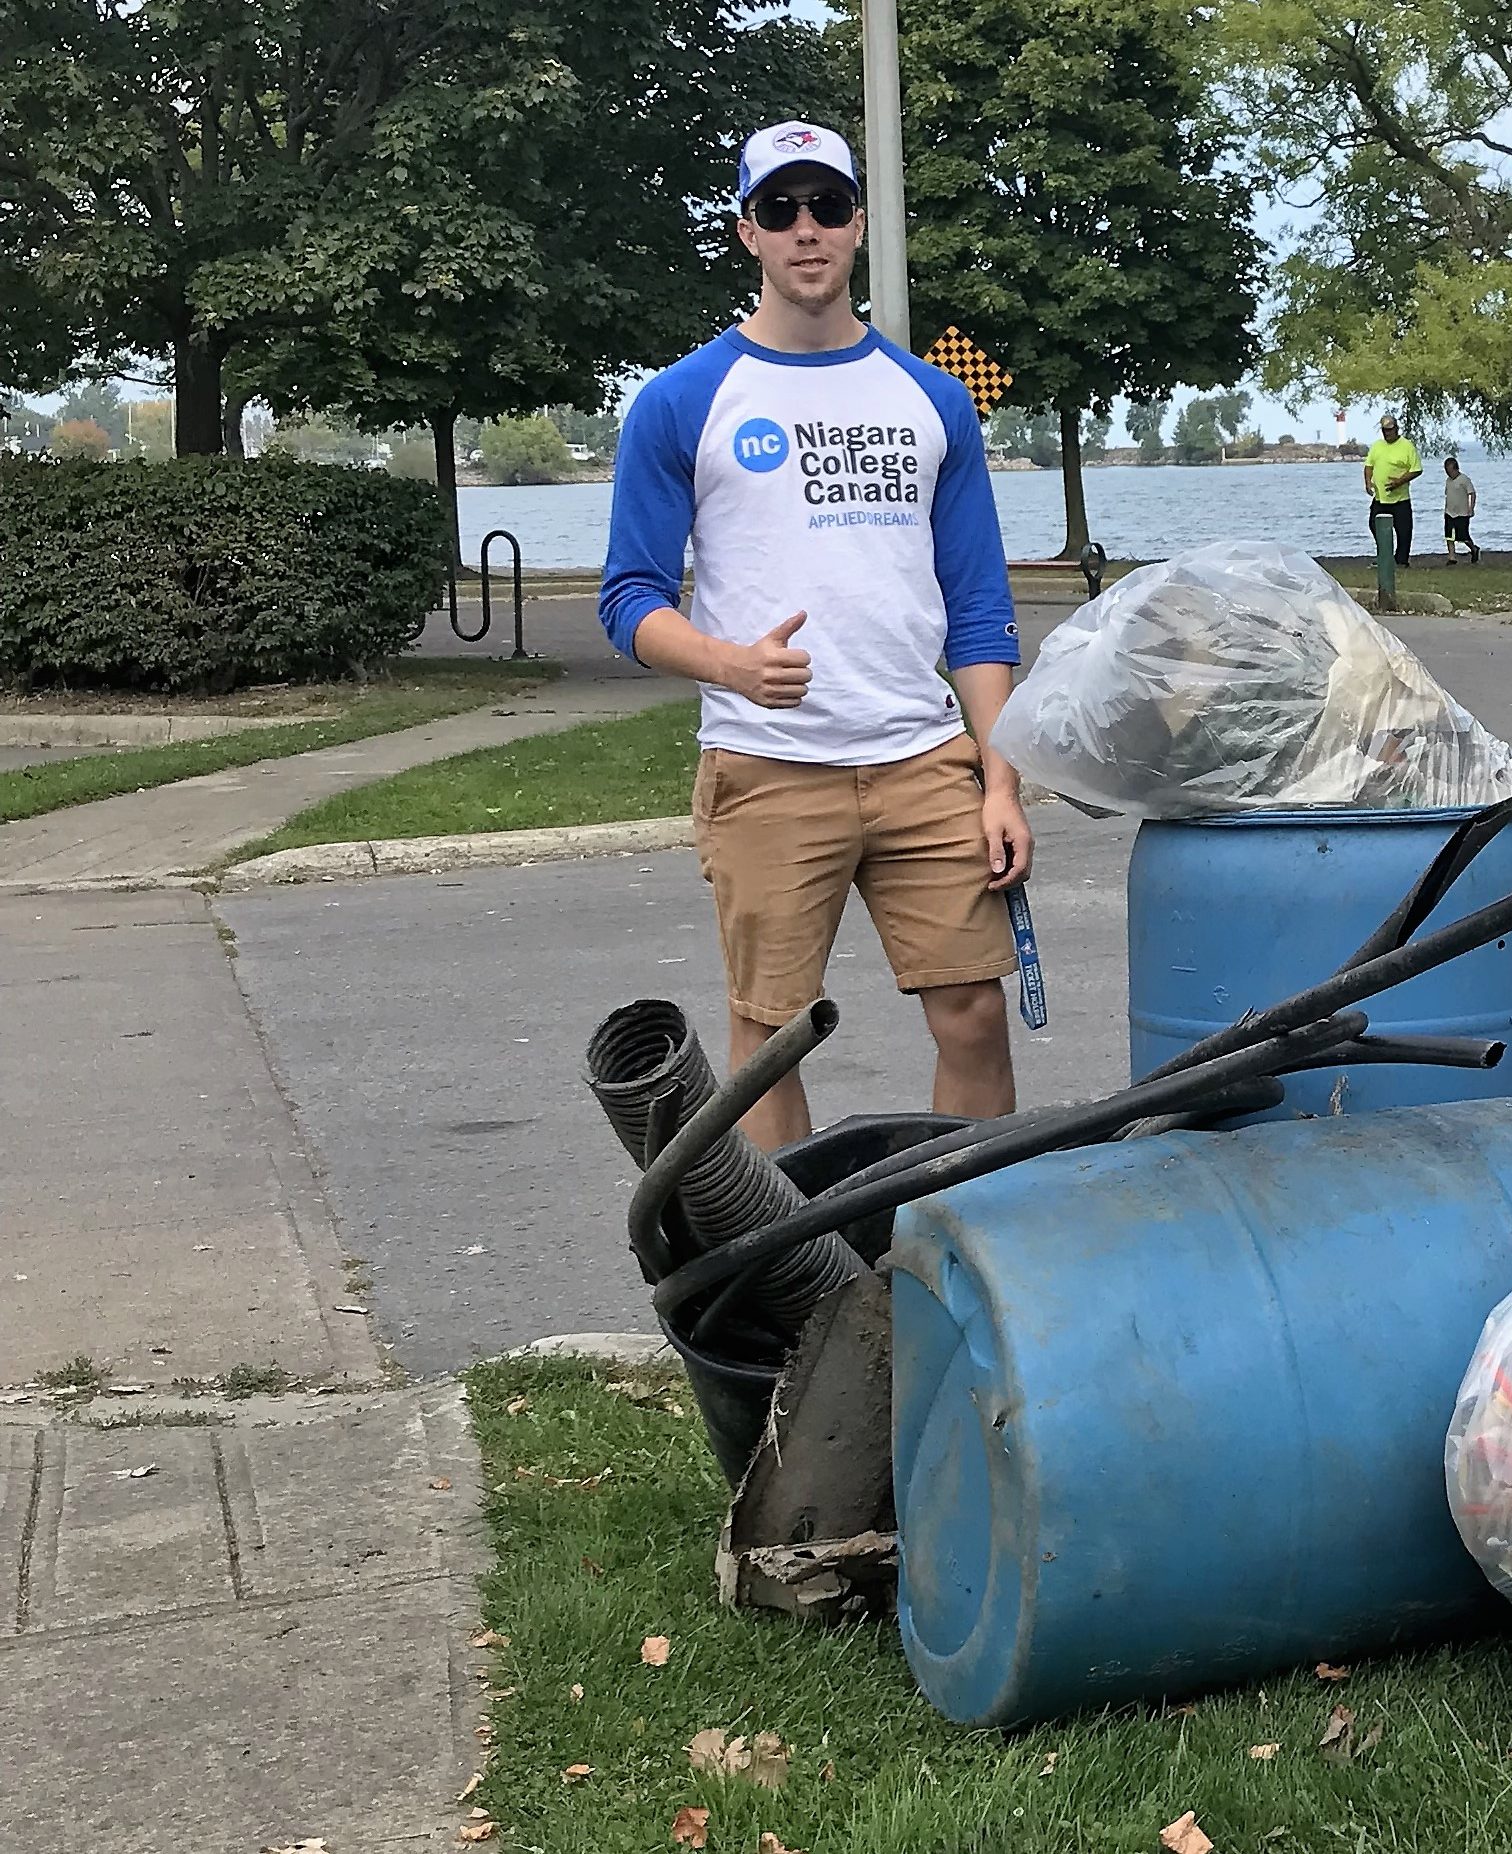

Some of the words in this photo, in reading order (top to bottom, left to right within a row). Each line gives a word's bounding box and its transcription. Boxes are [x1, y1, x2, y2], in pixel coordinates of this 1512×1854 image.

[740, 432, 782, 459] nc
[794, 422, 917, 451] Niagara
[800, 449, 918, 480] College
[804, 475, 919, 505] Canada
[1025, 965, 1036, 992] TICKET
[1030, 993, 1042, 1025] HOLDER
